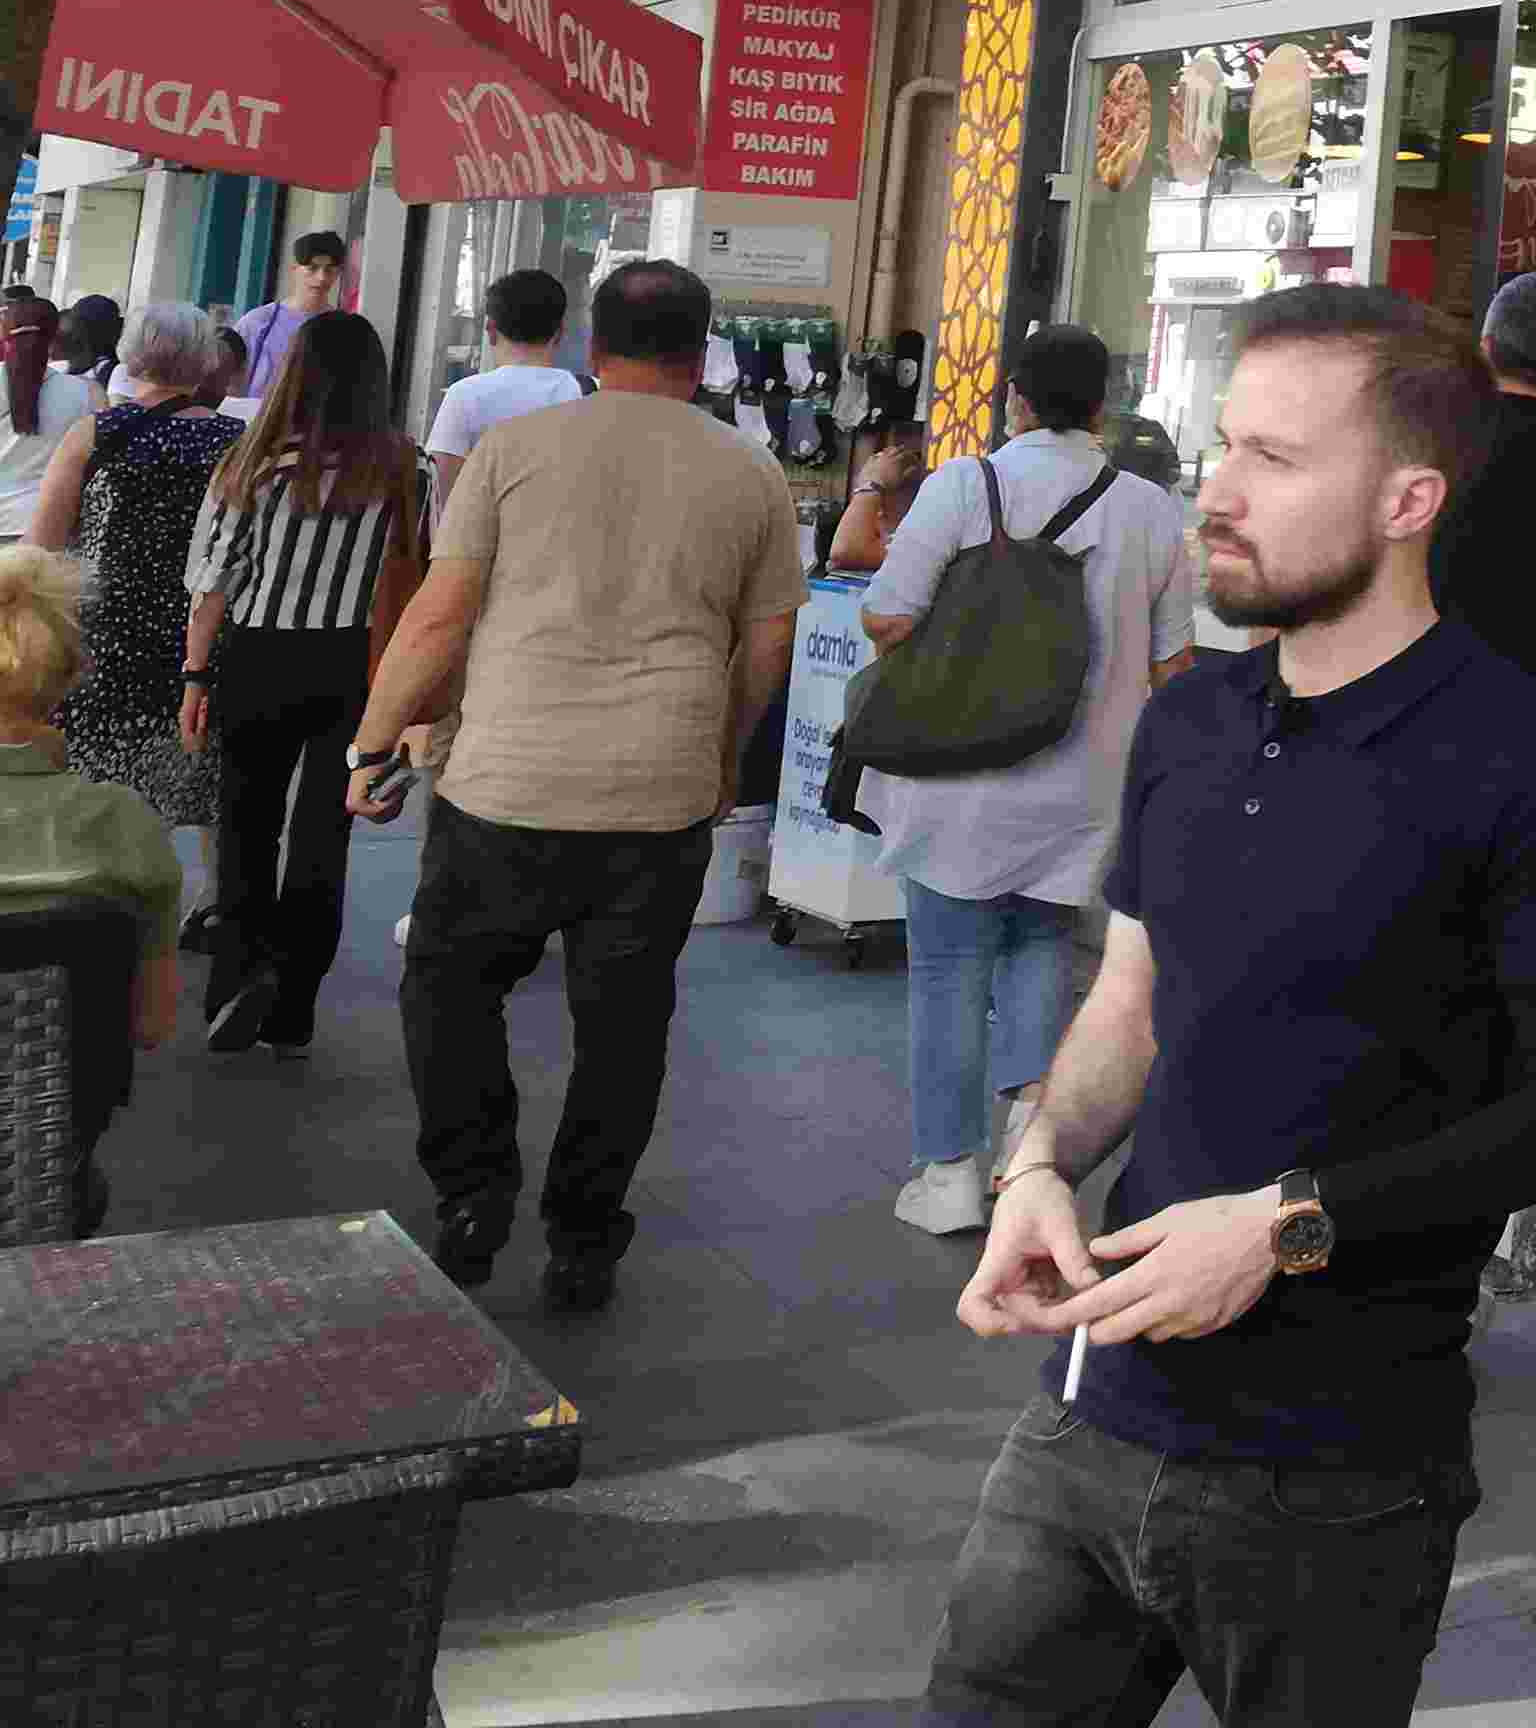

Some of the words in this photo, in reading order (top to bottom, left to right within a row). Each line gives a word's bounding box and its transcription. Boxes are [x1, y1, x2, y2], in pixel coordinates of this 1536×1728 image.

[742, 2, 842, 31] PEDİKÜR
[742, 35, 836, 62] MAKYAJ
[557, 8, 653, 129] ÇIKAR
[728, 65, 777, 93] KAŞ
[728, 95, 769, 121] SİR
[773, 99, 837, 126] AĞDA
[731, 131, 830, 158] PARAFİN
[739, 163, 816, 188] BAKIM
[806, 626, 858, 669] damla
